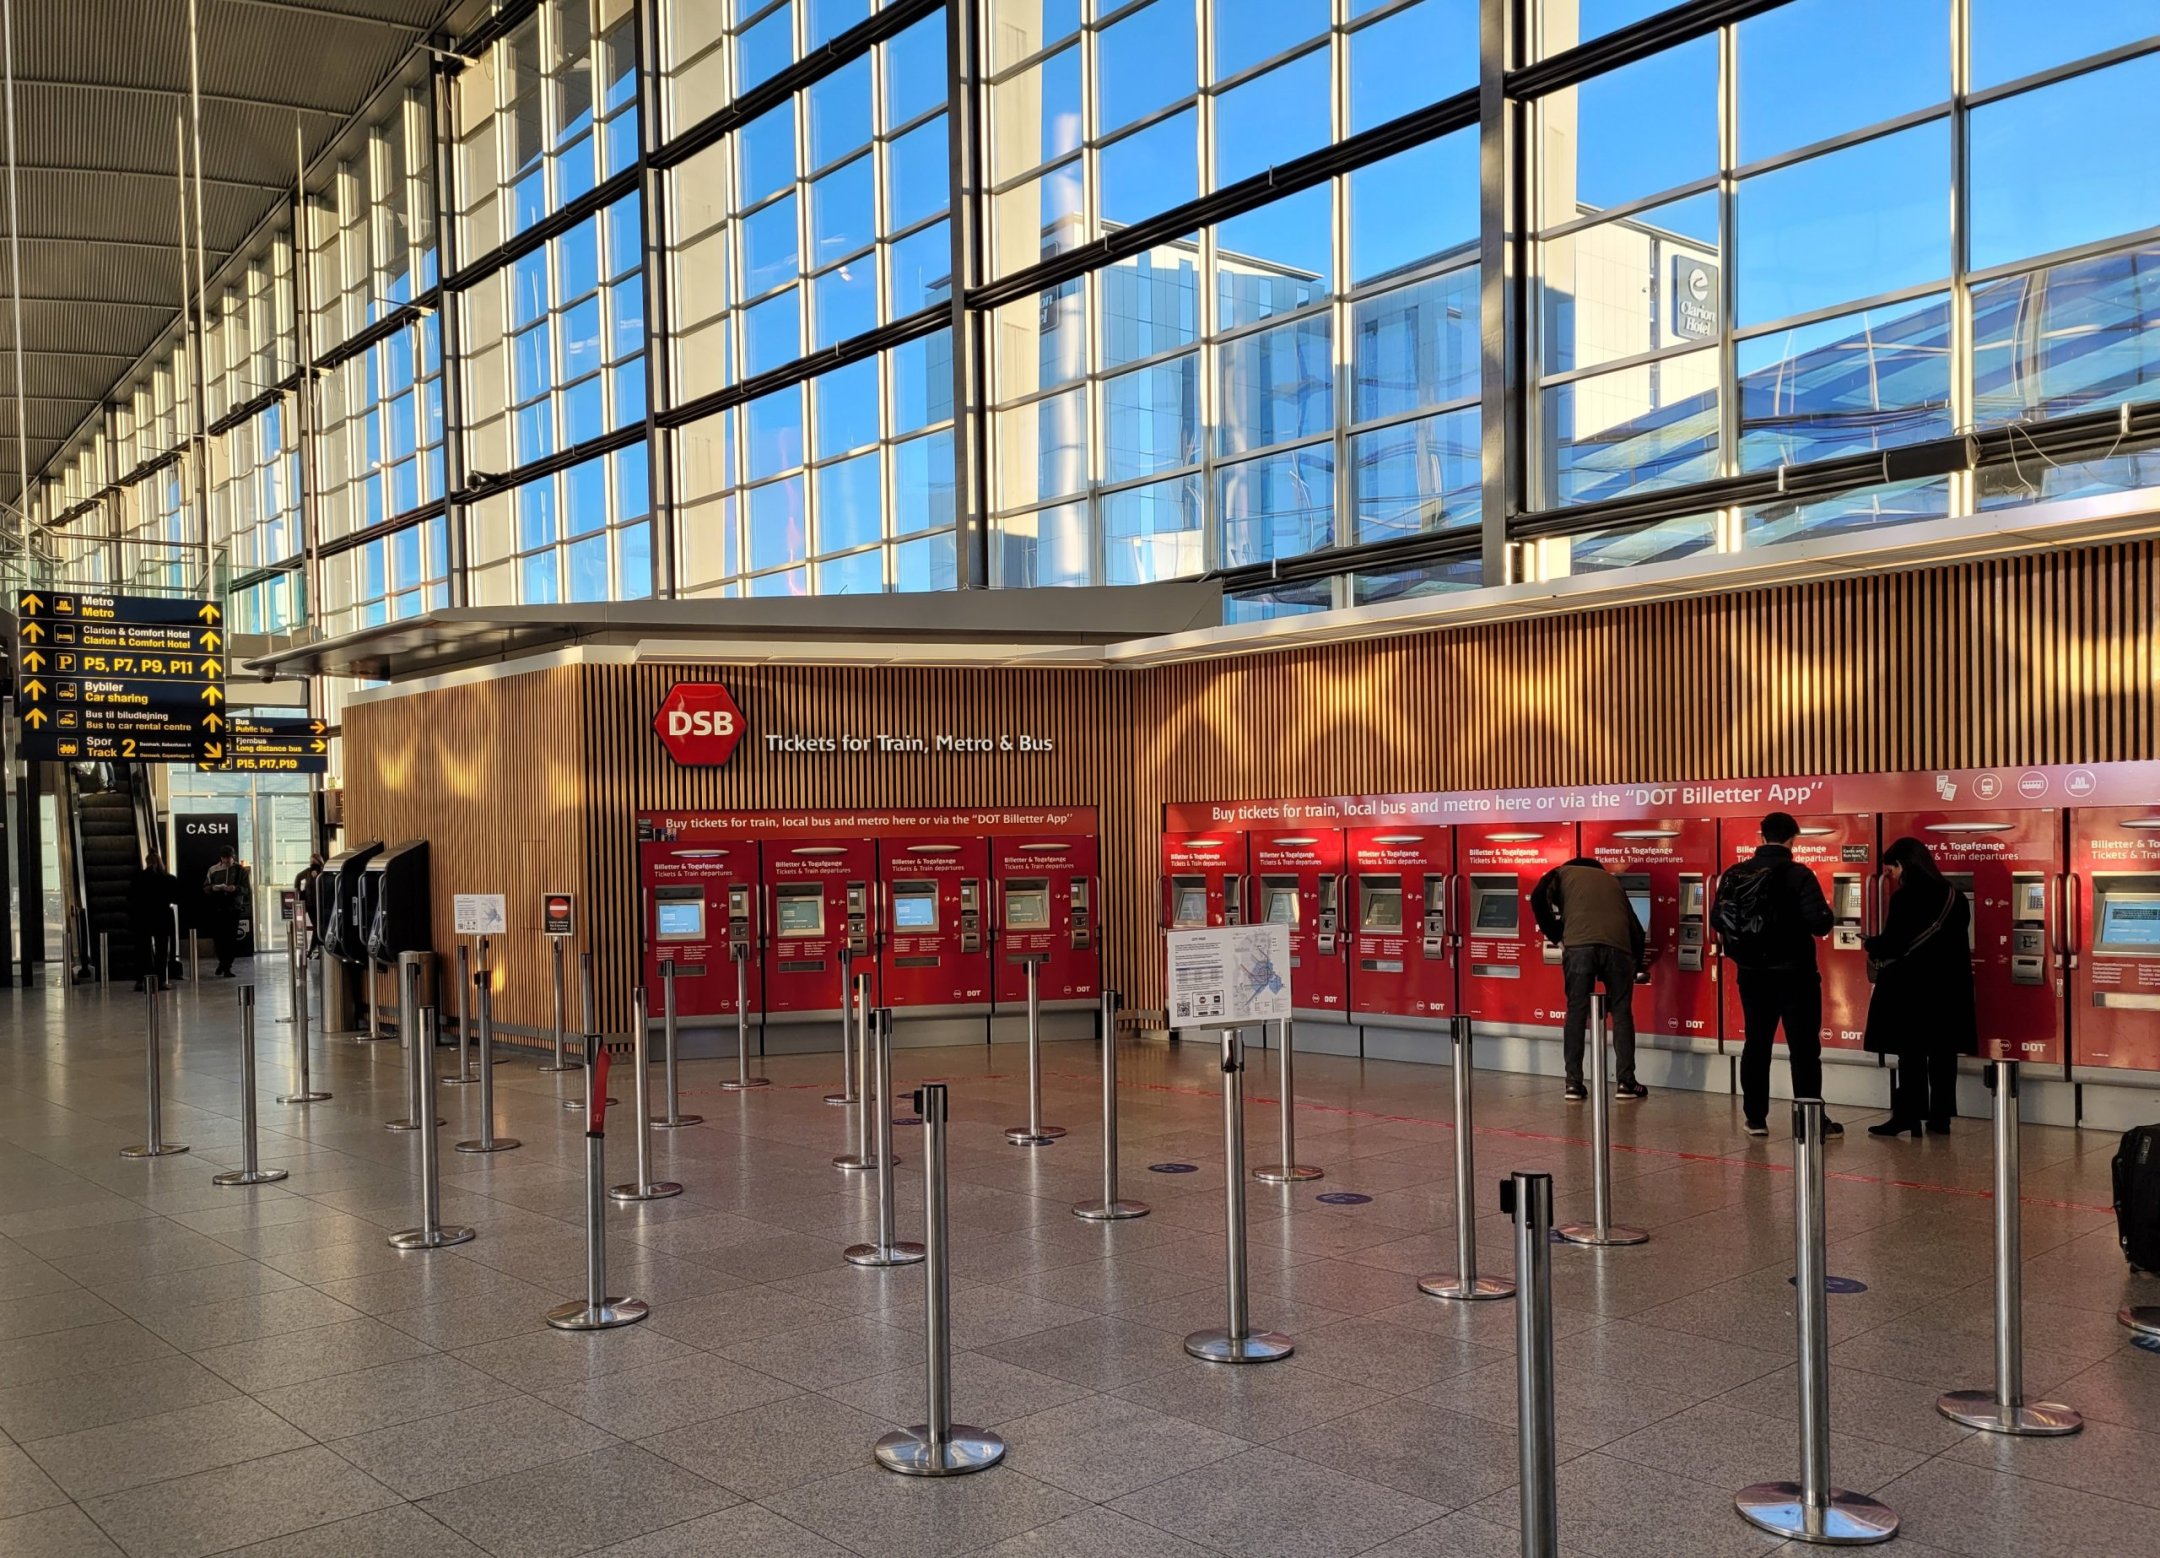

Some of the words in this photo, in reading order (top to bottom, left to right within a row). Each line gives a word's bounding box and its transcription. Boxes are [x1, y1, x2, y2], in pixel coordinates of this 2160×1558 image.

[1681, 301, 1715, 320] Clarion
[1686, 317, 1710, 336] Hotel
[82, 596, 114, 607] Metro
[82, 607, 114, 618] Metro
[83, 626, 116, 635] Clarion
[119, 628, 126, 636] &
[128, 628, 164, 637] Comfort
[167, 630, 190, 639] Hotel
[84, 636, 116, 645] Clarion
[119, 637, 126, 646] &
[129, 638, 165, 647] Comfort
[168, 640, 191, 648] Hotel
[84, 657, 109, 672] P5,
[114, 658, 137, 673] P7,
[141, 659, 166, 674] P9,
[170, 661, 192, 674] P11
[85, 692, 104, 702] Car
[107, 693, 148, 704] sharing
[86, 710, 102, 718] Bus
[106, 711, 114, 719] til
[118, 711, 168, 721] biludlejning
[86, 721, 103, 729] Bus
[668, 711, 734, 736] DSB
[87, 737, 112, 747] Spor
[765, 734, 836, 752] Tickets
[842, 734, 871, 751] for
[876, 735, 928, 754] Train,
[936, 735, 993, 751] Metro
[1000, 735, 1013, 751] &
[1019, 735, 1053, 751] Bus
[87, 748, 117, 757] Track
[122, 739, 136, 757] 2
[237, 760, 257, 769] P15,
[1213, 807, 1234, 823] Buy
[1239, 806, 1279, 819] tickets
[1283, 804, 1301, 818] for
[1306, 804, 1340, 819] train,
[1344, 800, 1376, 815] local
[1381, 799, 1406, 814] bus
[1411, 798, 1438, 813] and
[1444, 797, 1490, 811] metro
[1496, 795, 1531, 810] here
[1537, 796, 1552, 809] or
[1560, 793, 1585, 808] via
[1591, 791, 1620, 807] the
[1683, 786, 1762, 804] Billetter
[666, 819, 687, 830] Buy
[691, 818, 728, 828] tickets
[731, 817, 746, 827] for
[750, 818, 779, 828] train,
[782, 816, 808, 826] local
[811, 816, 831, 826] bus
[834, 816, 854, 826] and
[857, 816, 889, 825] metro
[893, 815, 916, 825] here
[919, 817, 930, 825] or
[933, 815, 949, 824] via
[953, 815, 969, 824] the
[1003, 814, 1044, 824] Billetter
[186, 824, 228, 834] CASH
[1950, 842, 2005, 851] Togafgange
[2091, 840, 2134, 849] Billetter
[2137, 840, 2145, 848] &
[1969, 853, 2018, 861] departures
[2092, 851, 2126, 859] Tickets
[2130, 851, 2138, 859] &
[2142, 851, 2160, 859] Trai
[1514, 857, 1548, 865] departures
[1550, 1011, 1566, 1019] DOT
[1686, 1020, 1704, 1029] DOT
[1841, 1031, 1862, 1040] DOT
[2022, 1042, 2046, 1052] DOT
